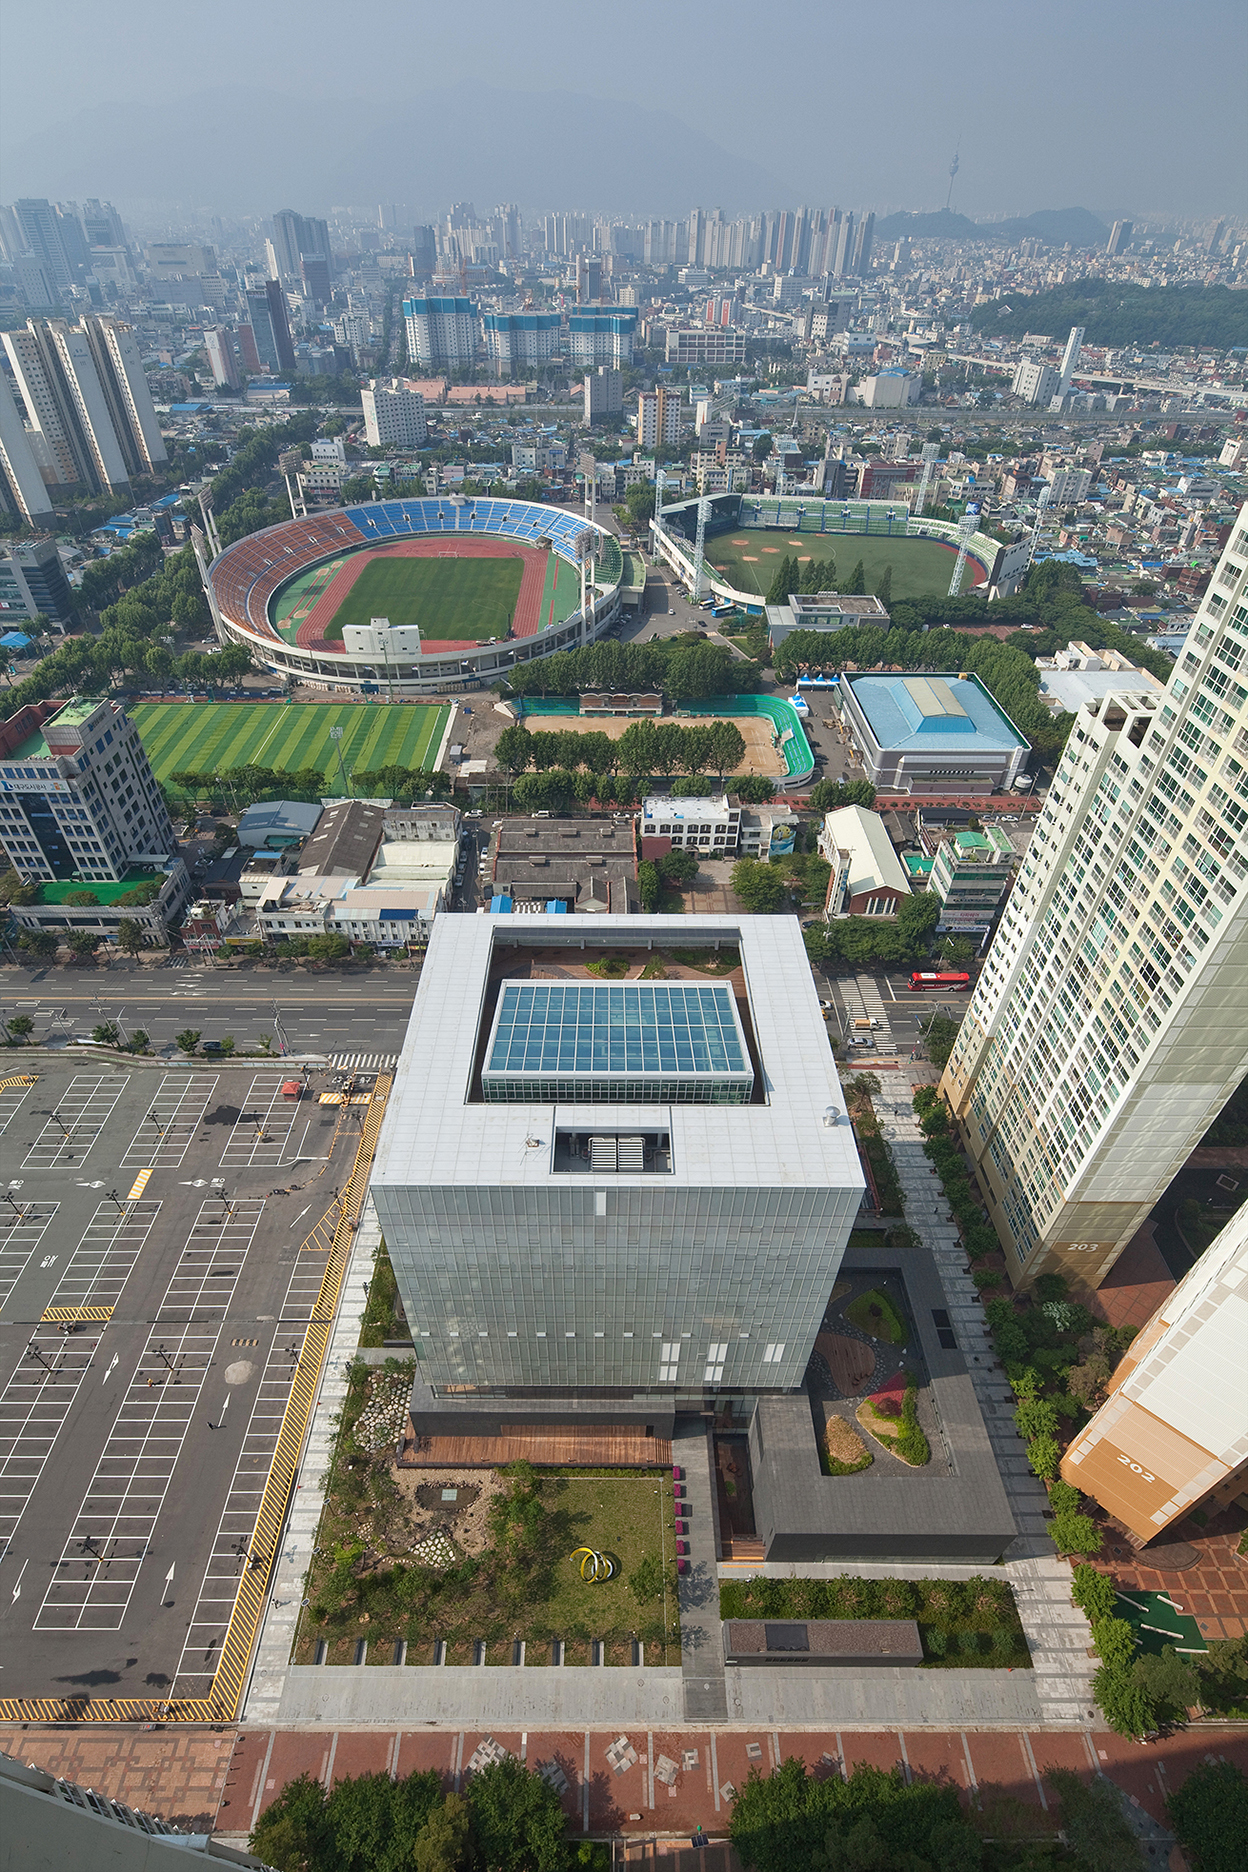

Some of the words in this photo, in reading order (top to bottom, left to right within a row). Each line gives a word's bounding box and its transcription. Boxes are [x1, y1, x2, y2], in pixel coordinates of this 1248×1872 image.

[13, 783, 47, 791] 대구도시공사
[1067, 1243, 1099, 1253] 203
[1116, 1454, 1156, 1484] 202
